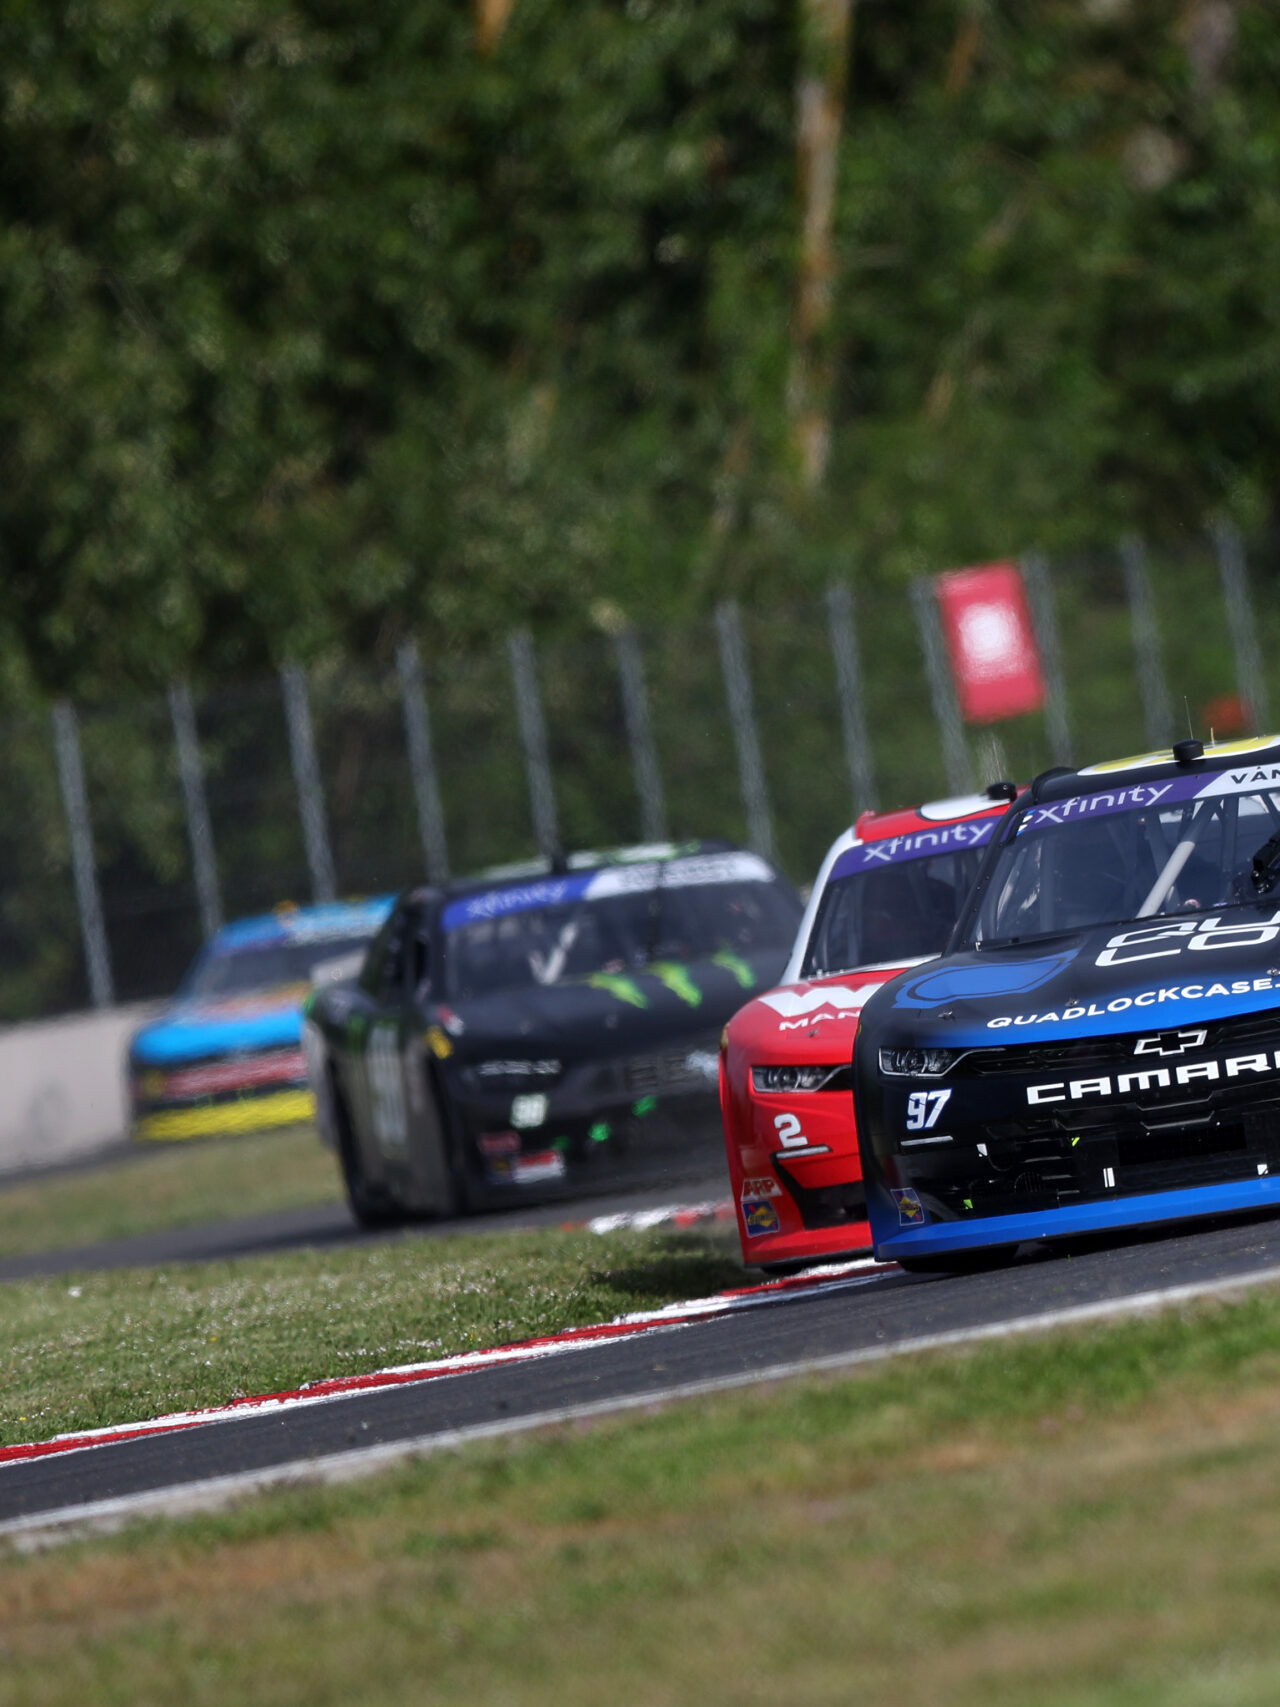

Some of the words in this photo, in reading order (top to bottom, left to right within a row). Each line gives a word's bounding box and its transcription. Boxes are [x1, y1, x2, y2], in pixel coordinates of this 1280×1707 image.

[1035, 784, 1174, 824] xfinity
[863, 822, 994, 862] xfinity
[906, 1089, 951, 1130] 97
[773, 1113, 808, 1148] 2
